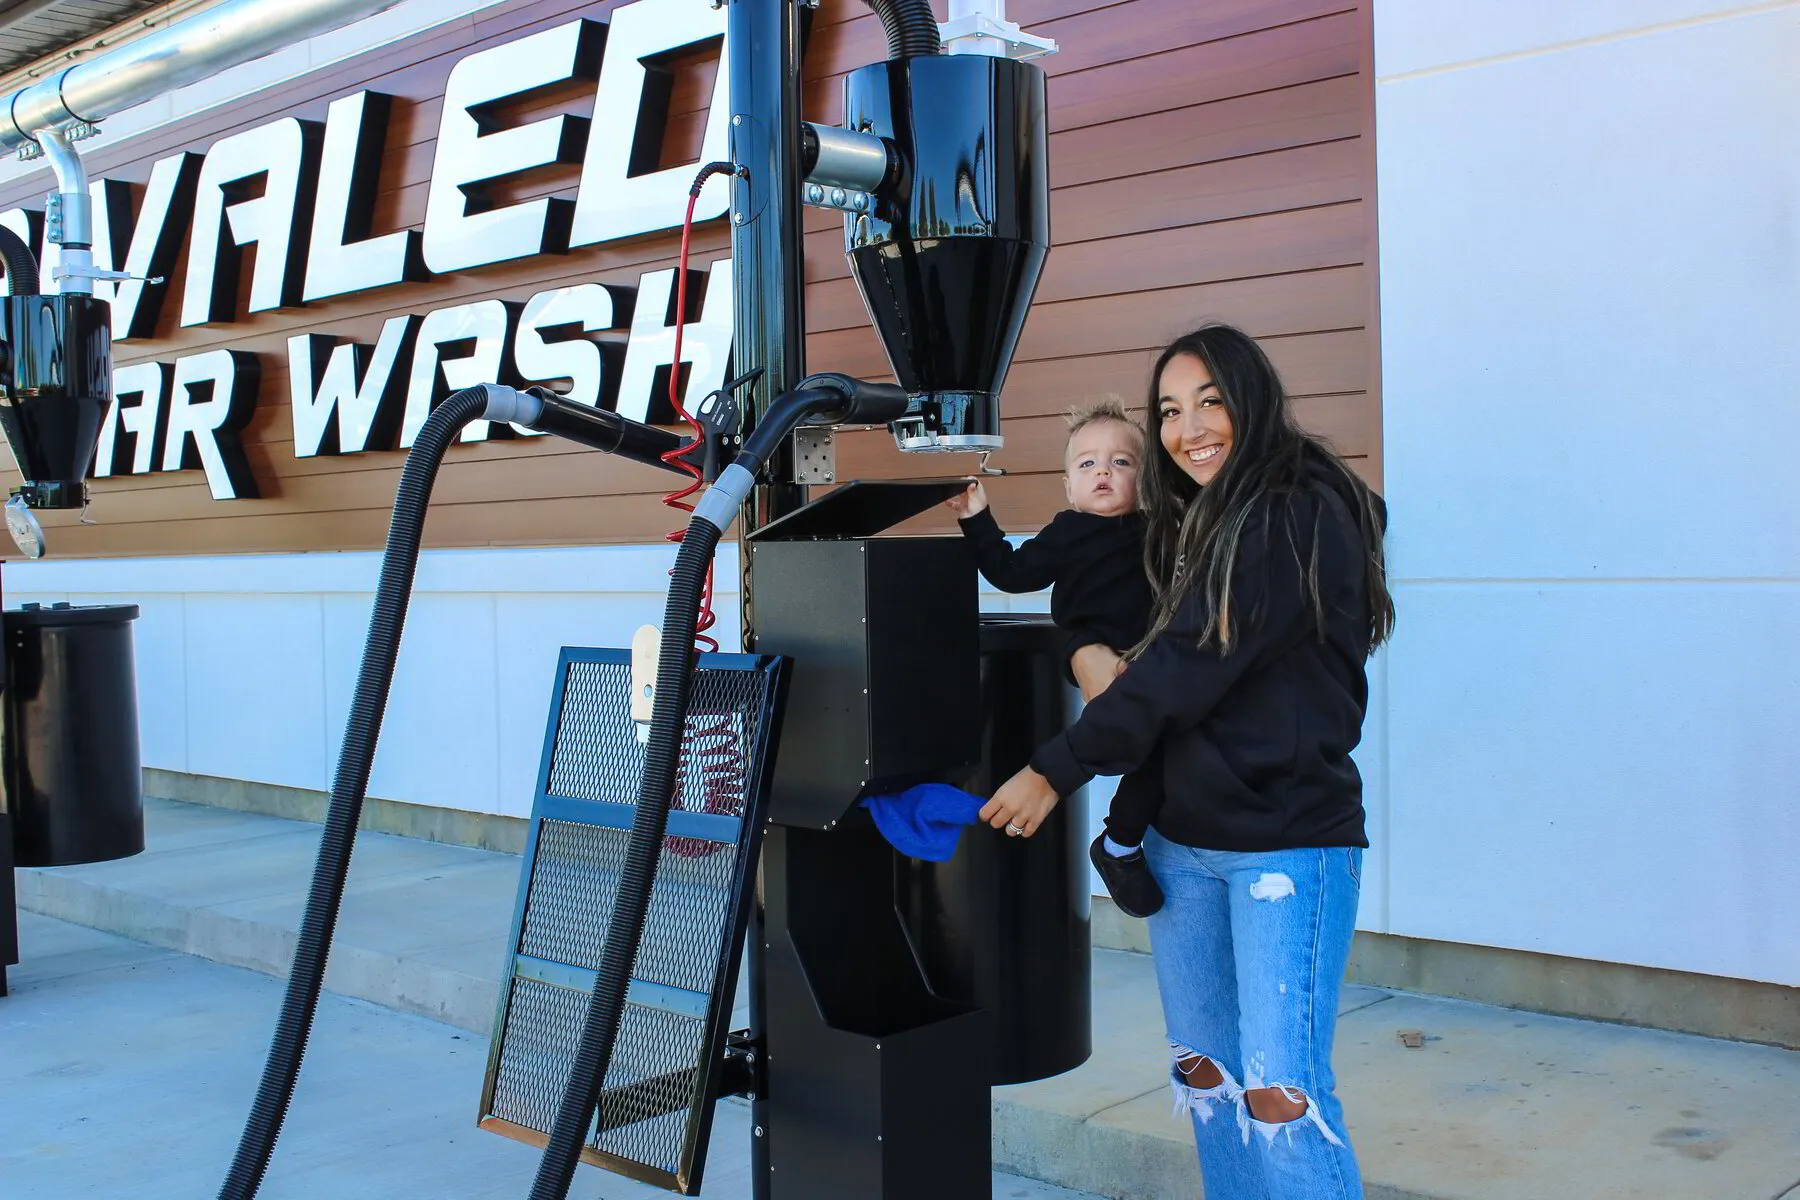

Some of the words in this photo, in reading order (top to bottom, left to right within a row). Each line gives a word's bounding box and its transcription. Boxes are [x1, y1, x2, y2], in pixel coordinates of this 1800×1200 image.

[0, 0, 732, 341] VALED
[93, 349, 238, 500] AR
[286, 258, 734, 458] WASH
